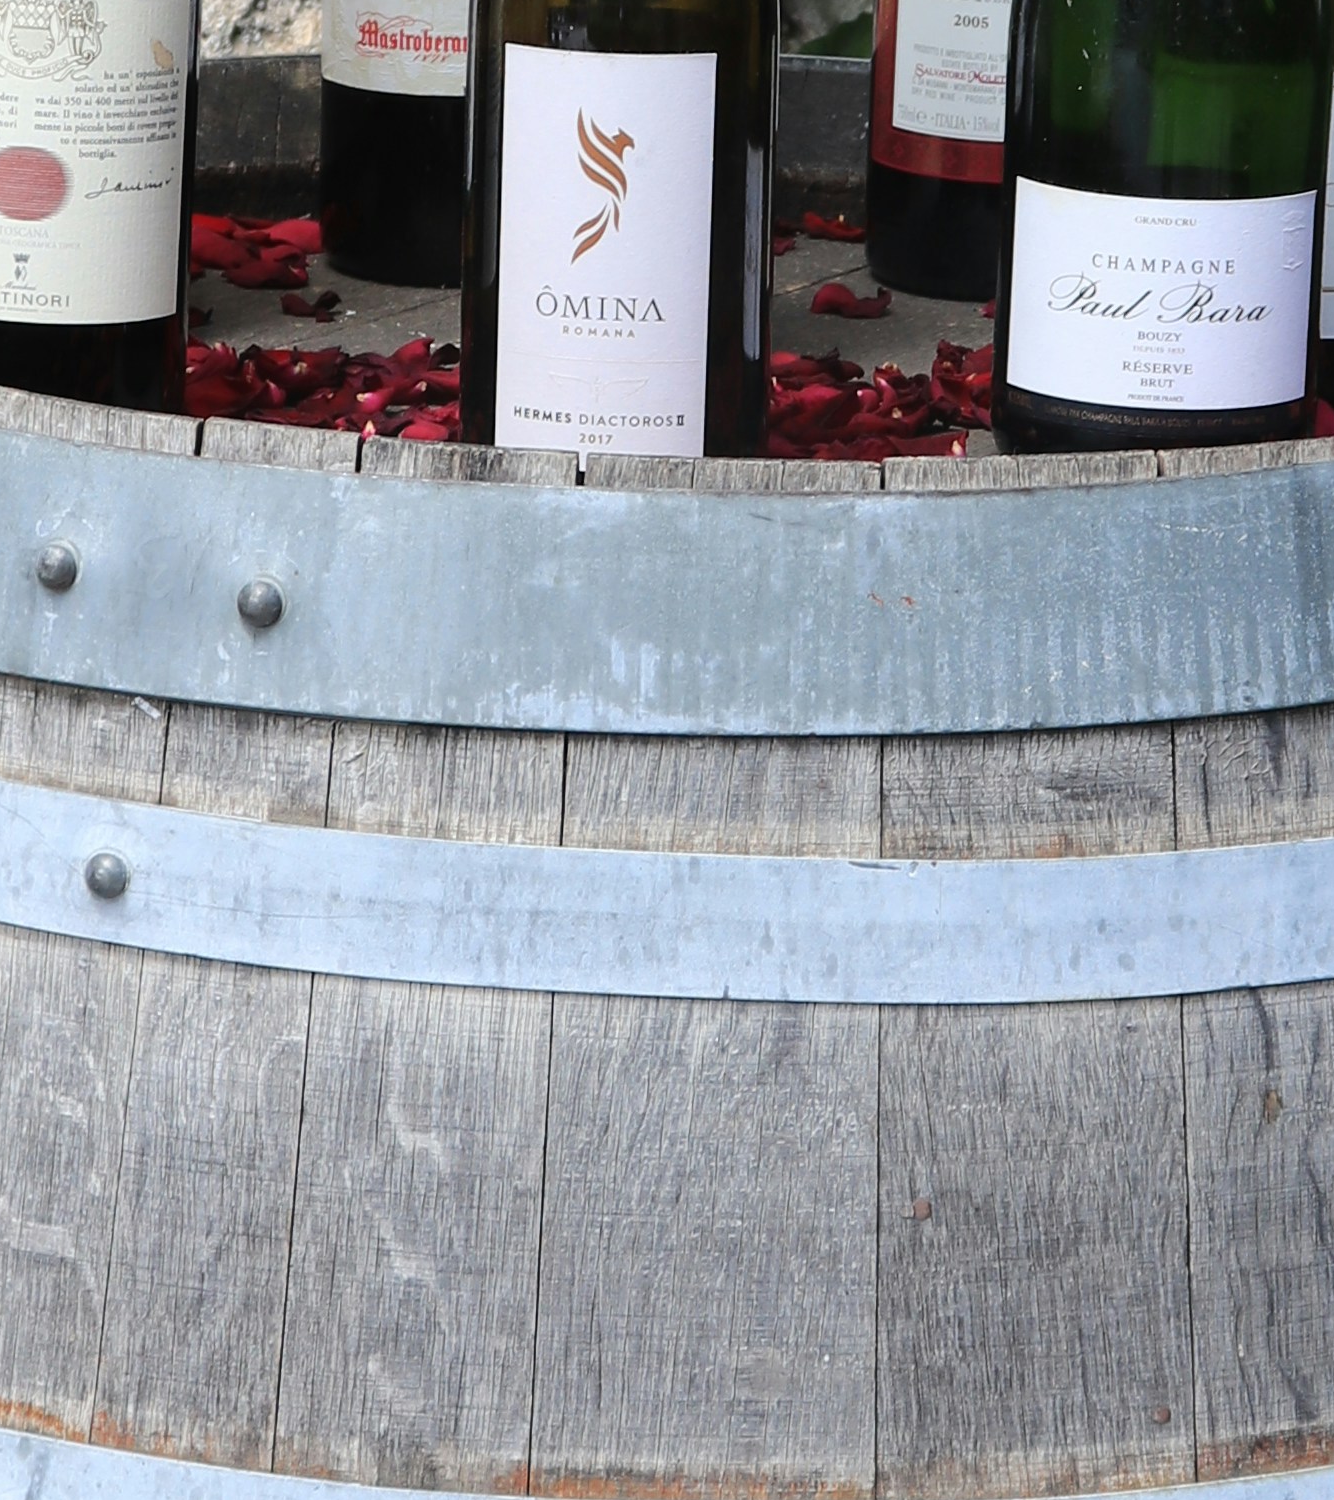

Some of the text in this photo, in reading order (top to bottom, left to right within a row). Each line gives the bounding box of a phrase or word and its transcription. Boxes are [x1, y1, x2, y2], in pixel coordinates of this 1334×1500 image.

[954, 14, 990, 29] 2005
[64, 97, 81, 105] 350
[95, 97, 111, 105] 400
[73, 110, 92, 119] vino
[1135, 215, 1197, 227] GRAND CRU
[1092, 253, 1236, 274] CHAMPAGNE
[1047, 271, 1274, 324] Paul Bara
[562, 325, 636, 338] ROMANA
[1138, 331, 1182, 342] BOUZY
[1122, 360, 1193, 375] RÉSERVE
[1140, 378, 1175, 388] BRUT
[514, 405, 572, 424] HERMES
[579, 414, 673, 427] DIACTOROS
[579, 433, 613, 445] 2017
